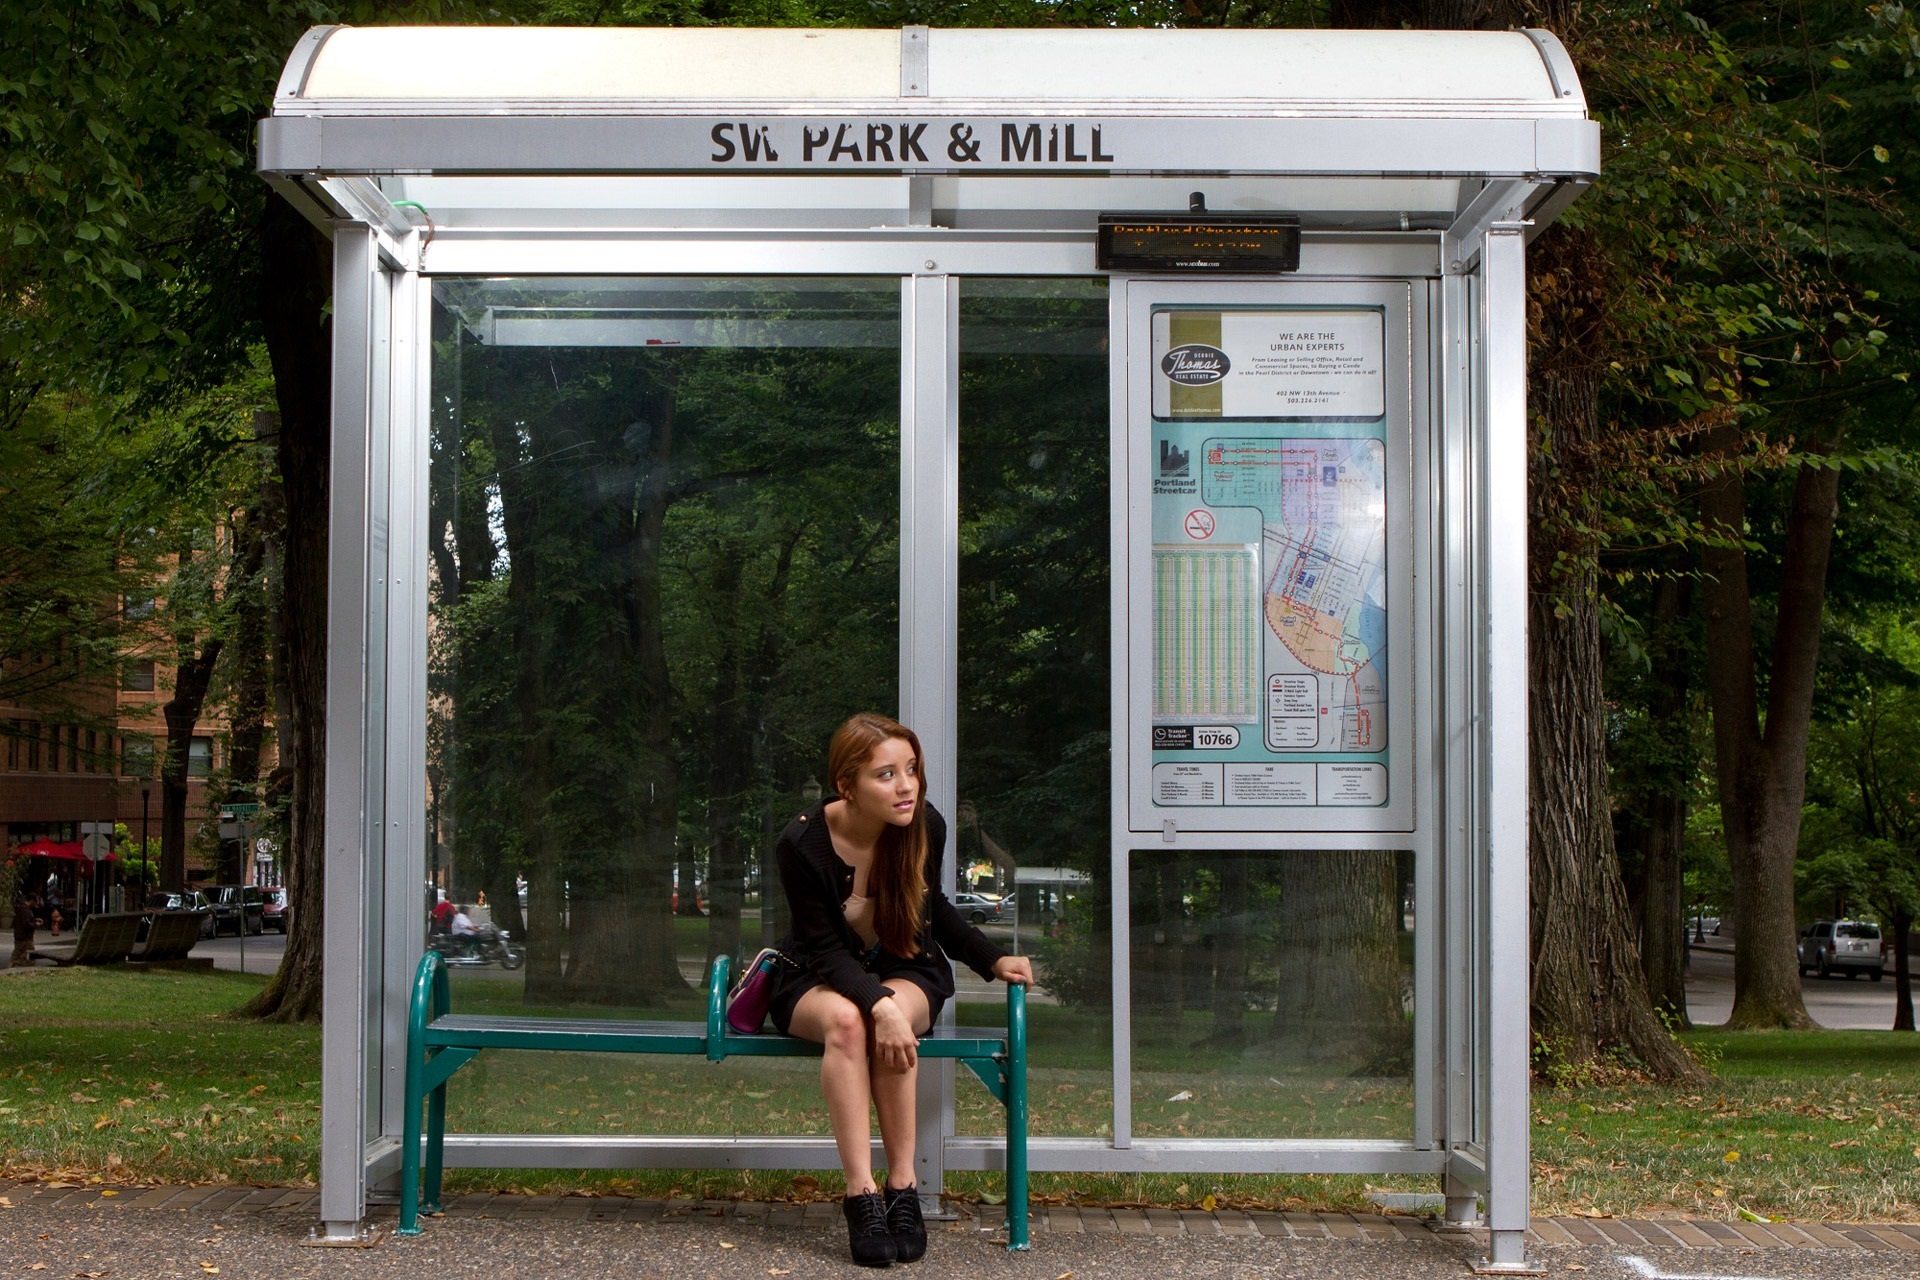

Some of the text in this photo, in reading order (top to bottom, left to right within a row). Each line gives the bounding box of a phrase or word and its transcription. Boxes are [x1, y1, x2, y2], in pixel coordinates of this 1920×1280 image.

[803, 123, 929, 162] PARK
[947, 122, 982, 162] &
[1001, 123, 1114, 162] MILL
[1306, 343, 1345, 351] EXPERTS
[1167, 350, 1221, 375] Thomas
[1154, 479, 1196, 487] Portland
[1153, 487, 1197, 495] Streetcar
[1198, 734, 1233, 746] 10766
